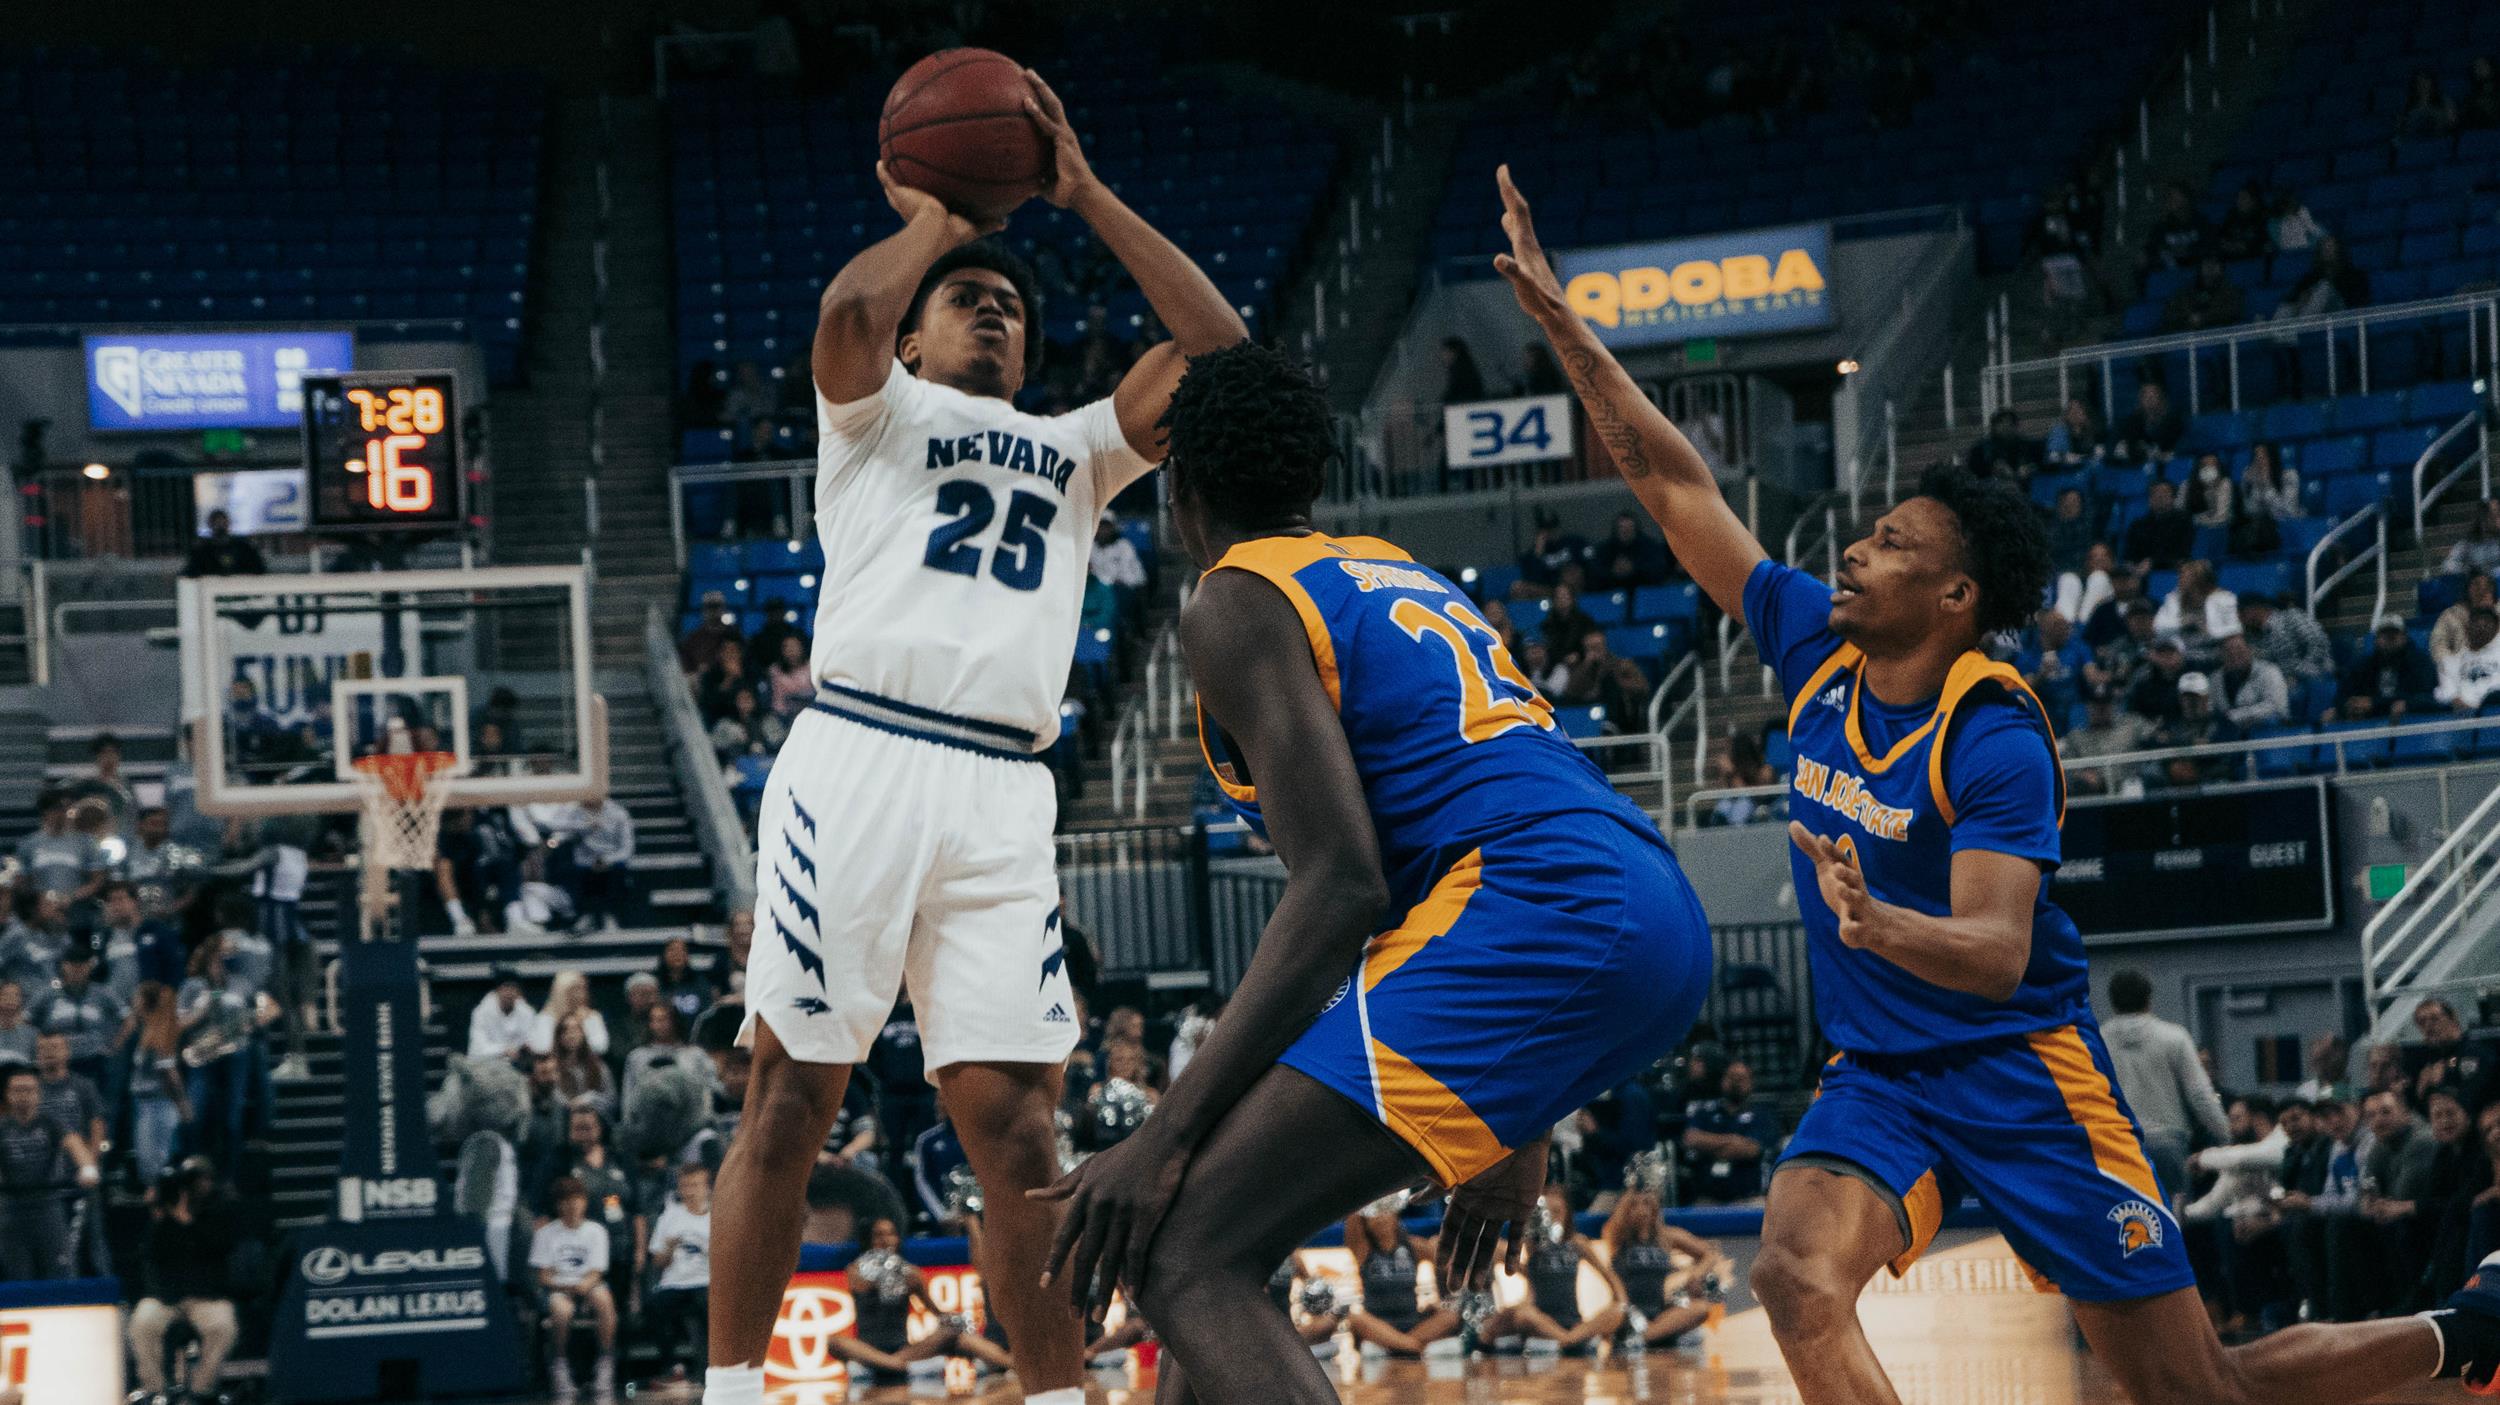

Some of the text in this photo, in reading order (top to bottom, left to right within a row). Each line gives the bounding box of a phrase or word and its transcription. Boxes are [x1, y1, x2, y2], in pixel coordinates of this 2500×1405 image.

[1565, 248, 1826, 330] QDOBA
[347, 387, 445, 435] 7:28
[1467, 405, 1553, 458] 34
[366, 434, 434, 512] 16
[926, 430, 1077, 497] NEVADA
[922, 478, 1058, 592] 25
[1794, 753, 1830, 803] SAN
[1859, 789, 1914, 842] STATE
[2249, 842, 2308, 868] GUEST
[363, 1177, 438, 1209] NSB
[352, 1246, 486, 1276] LEXUS
[305, 1289, 487, 1324] DOLAN LEXUS
